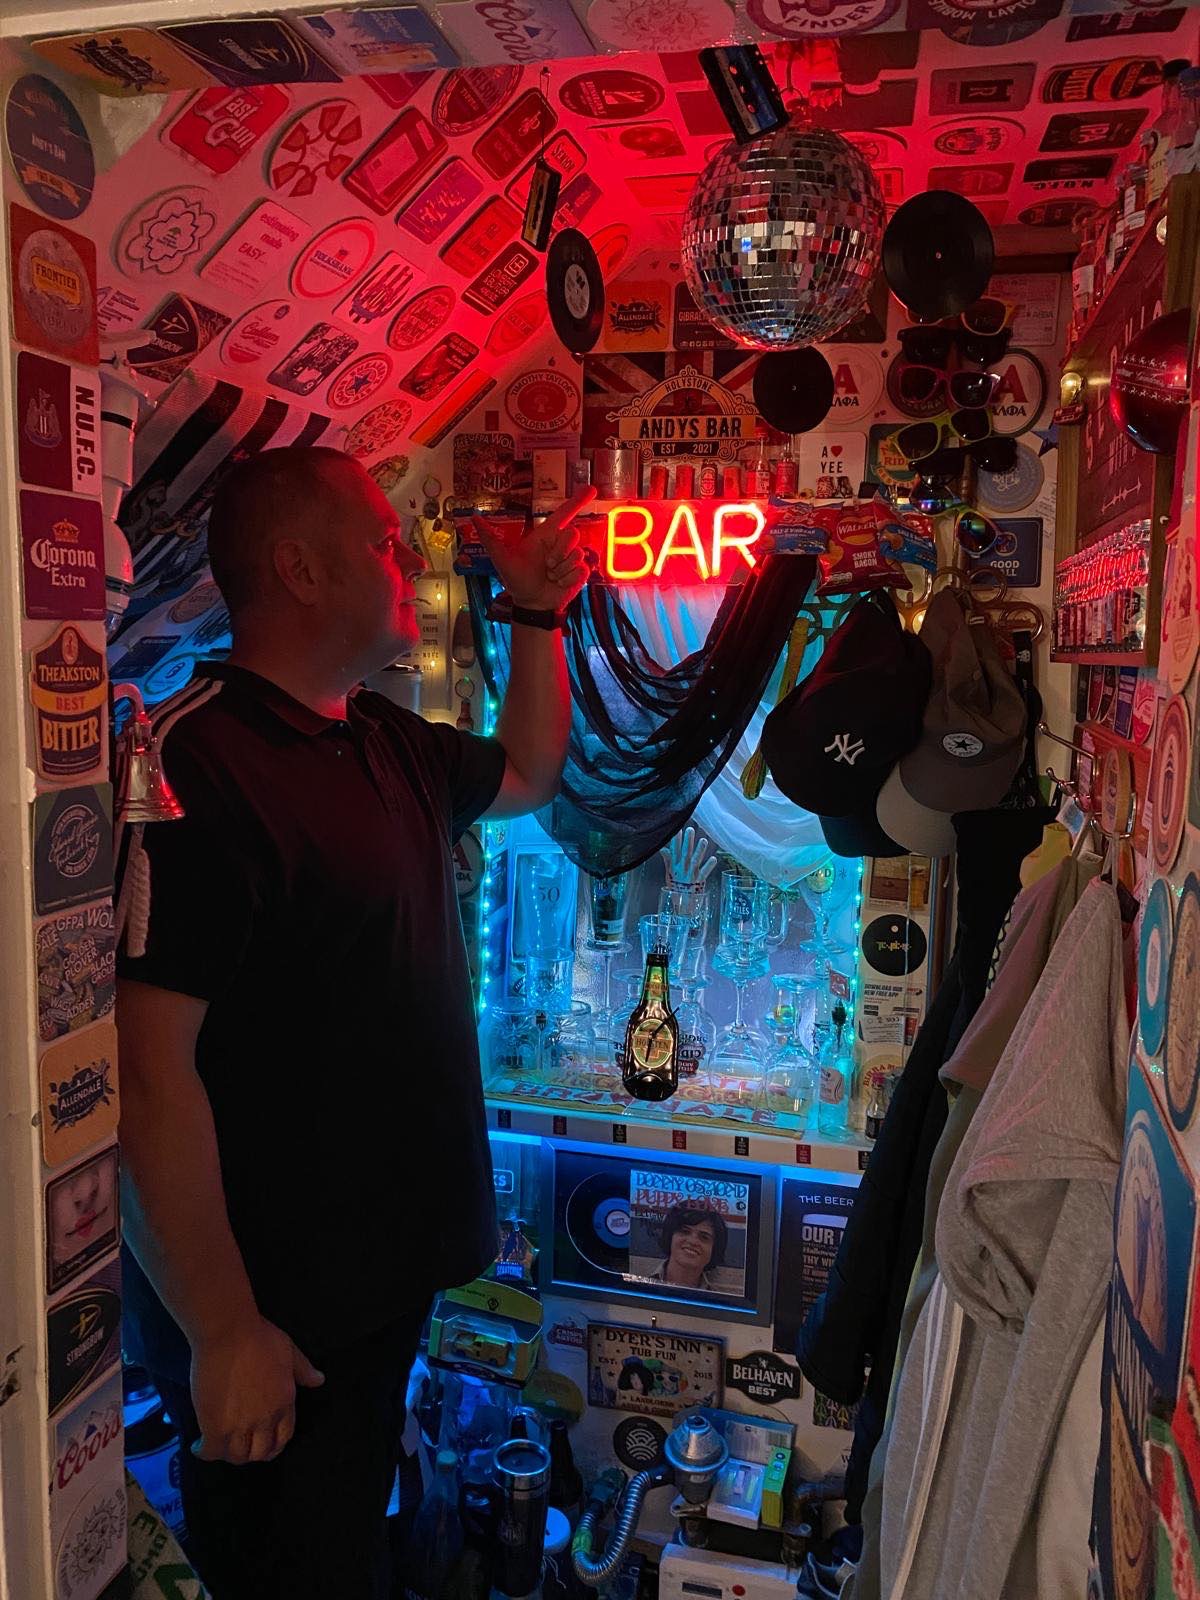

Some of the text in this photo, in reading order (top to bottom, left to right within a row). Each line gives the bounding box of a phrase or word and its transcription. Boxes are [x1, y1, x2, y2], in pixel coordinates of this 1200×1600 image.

[785, 5, 873, 29] FINDER
[475, 0, 534, 62] Coors
[194, 87, 264, 123] Last
[205, 116, 257, 149] Gun
[1079, 122, 1110, 144] IPA
[259, 213, 299, 242] estimating
[238, 242, 267, 261] EASY
[259, 233, 283, 250] made
[34, 263, 78, 290] FRONTIER
[510, 373, 545, 397] TIMOTHY
[664, 377, 714, 393] HOLYSTONE
[514, 412, 570, 430] GOLDEN BEST
[640, 417, 743, 439] ANDYS BAR
[75, 384, 96, 481] N.U.F.C.
[660, 443, 713, 455] EST 2021
[821, 445, 829, 458] A
[820, 461, 843, 474] YEE
[605, 502, 767, 581] BAR
[29, 537, 98, 573] Corona
[851, 550, 877, 562] SMOKY
[853, 558, 878, 569] BACON
[990, 560, 1020, 569] GOOD
[50, 567, 87, 589] Extra
[38, 664, 100, 683] THEAKSTON
[56, 695, 85, 711] BEST
[40, 716, 100, 752] BITTER
[54, 915, 85, 931] GFPA
[62, 935, 97, 969] GOLDEN
[64, 947, 99, 982] PLOVER
[60, 1078, 102, 1111] ALLENDALE
[798, 1195, 855, 1208] THE BEER
[802, 1225, 835, 1244] OUR
[802, 1254, 822, 1265] THY
[65, 1326, 105, 1367] STRONGBOW
[606, 1328, 667, 1349] DYER'S
[670, 1338, 702, 1354] INN
[598, 1356, 618, 1366] EST.
[629, 1346, 677, 1361] TUB FUN
[732, 1363, 795, 1388] BELHAVEN
[748, 1385, 777, 1397] BEST
[57, 1412, 122, 1490] Coors
